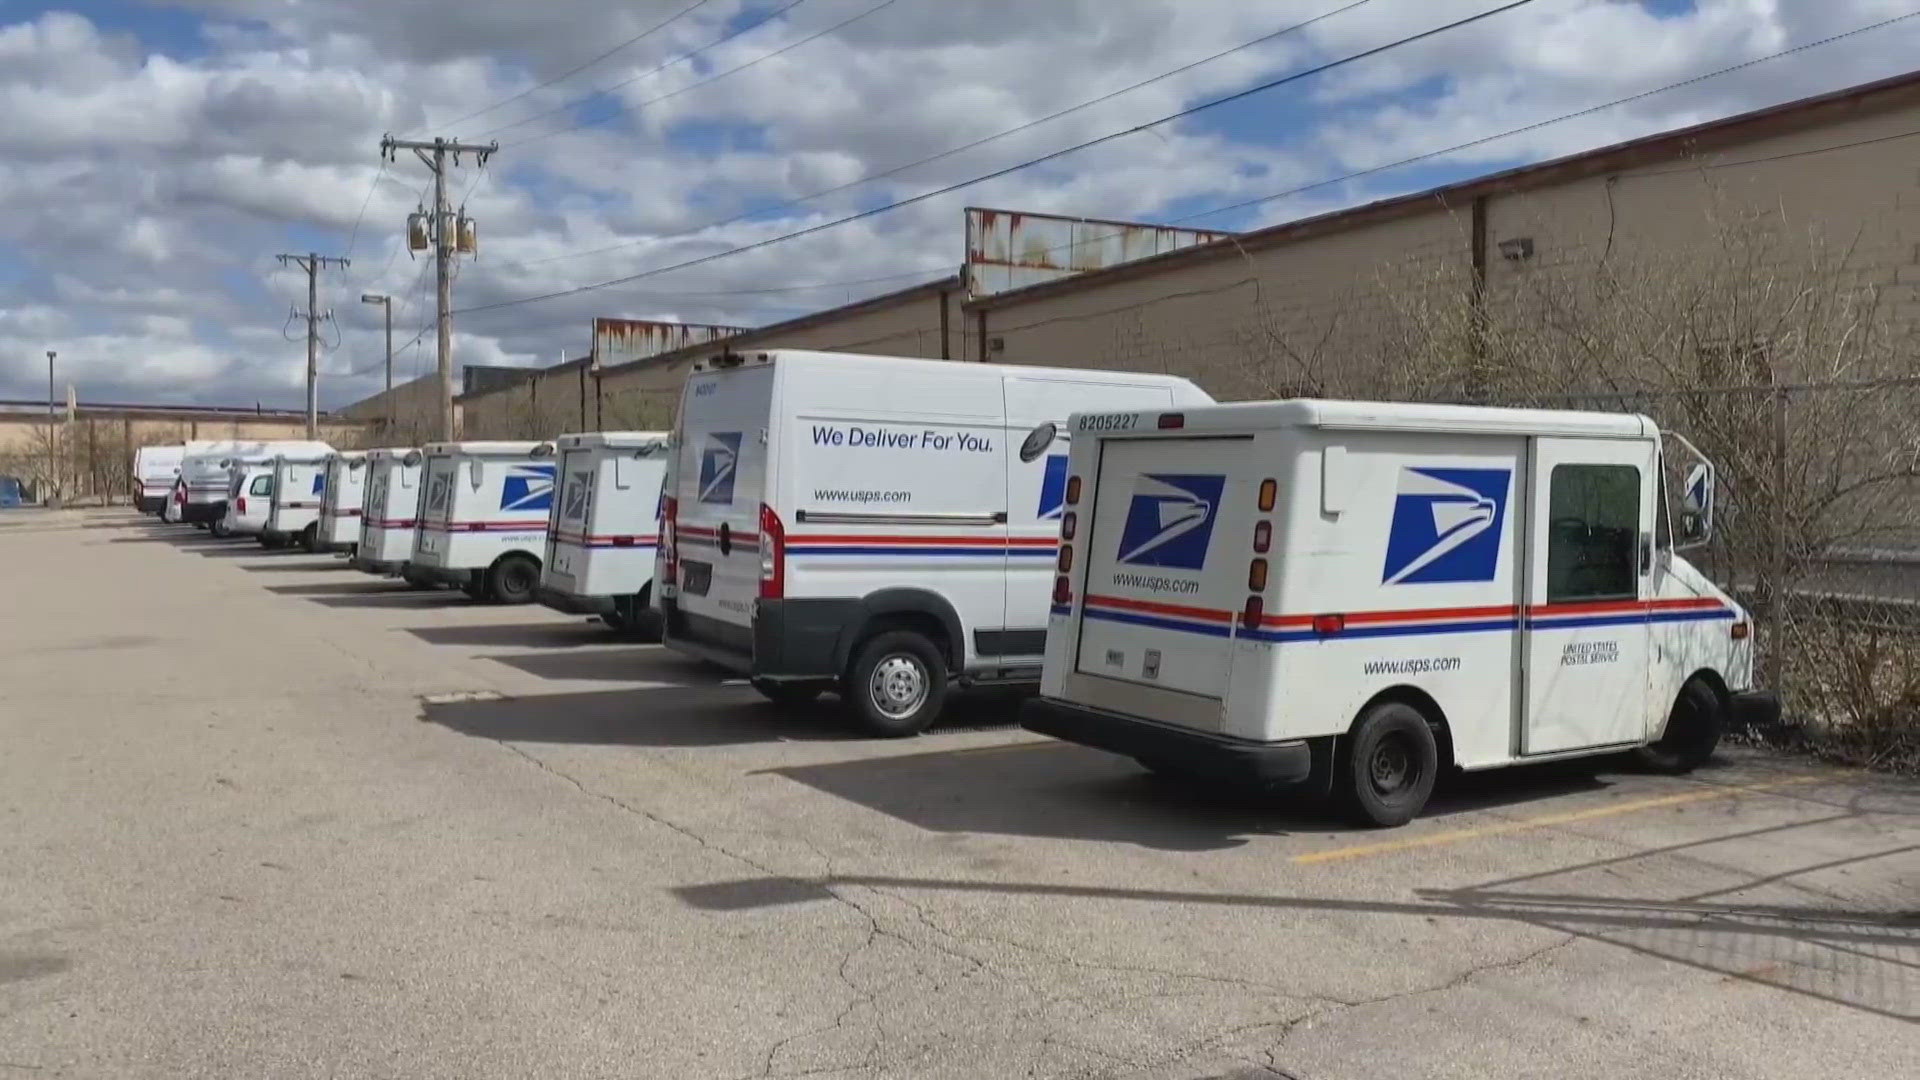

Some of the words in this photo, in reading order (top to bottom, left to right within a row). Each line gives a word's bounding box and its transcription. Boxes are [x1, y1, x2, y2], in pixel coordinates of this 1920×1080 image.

[1079, 413, 1139, 430] 8205227
[813, 425, 843, 445] We
[849, 427, 917, 449] Deliver
[921, 430, 953, 450] For
[957, 432, 993, 452] You.
[814, 489, 911, 503] www.usps.com
[1113, 573, 1199, 594] www.usps.com
[1364, 657, 1461, 676] www.usps.com
